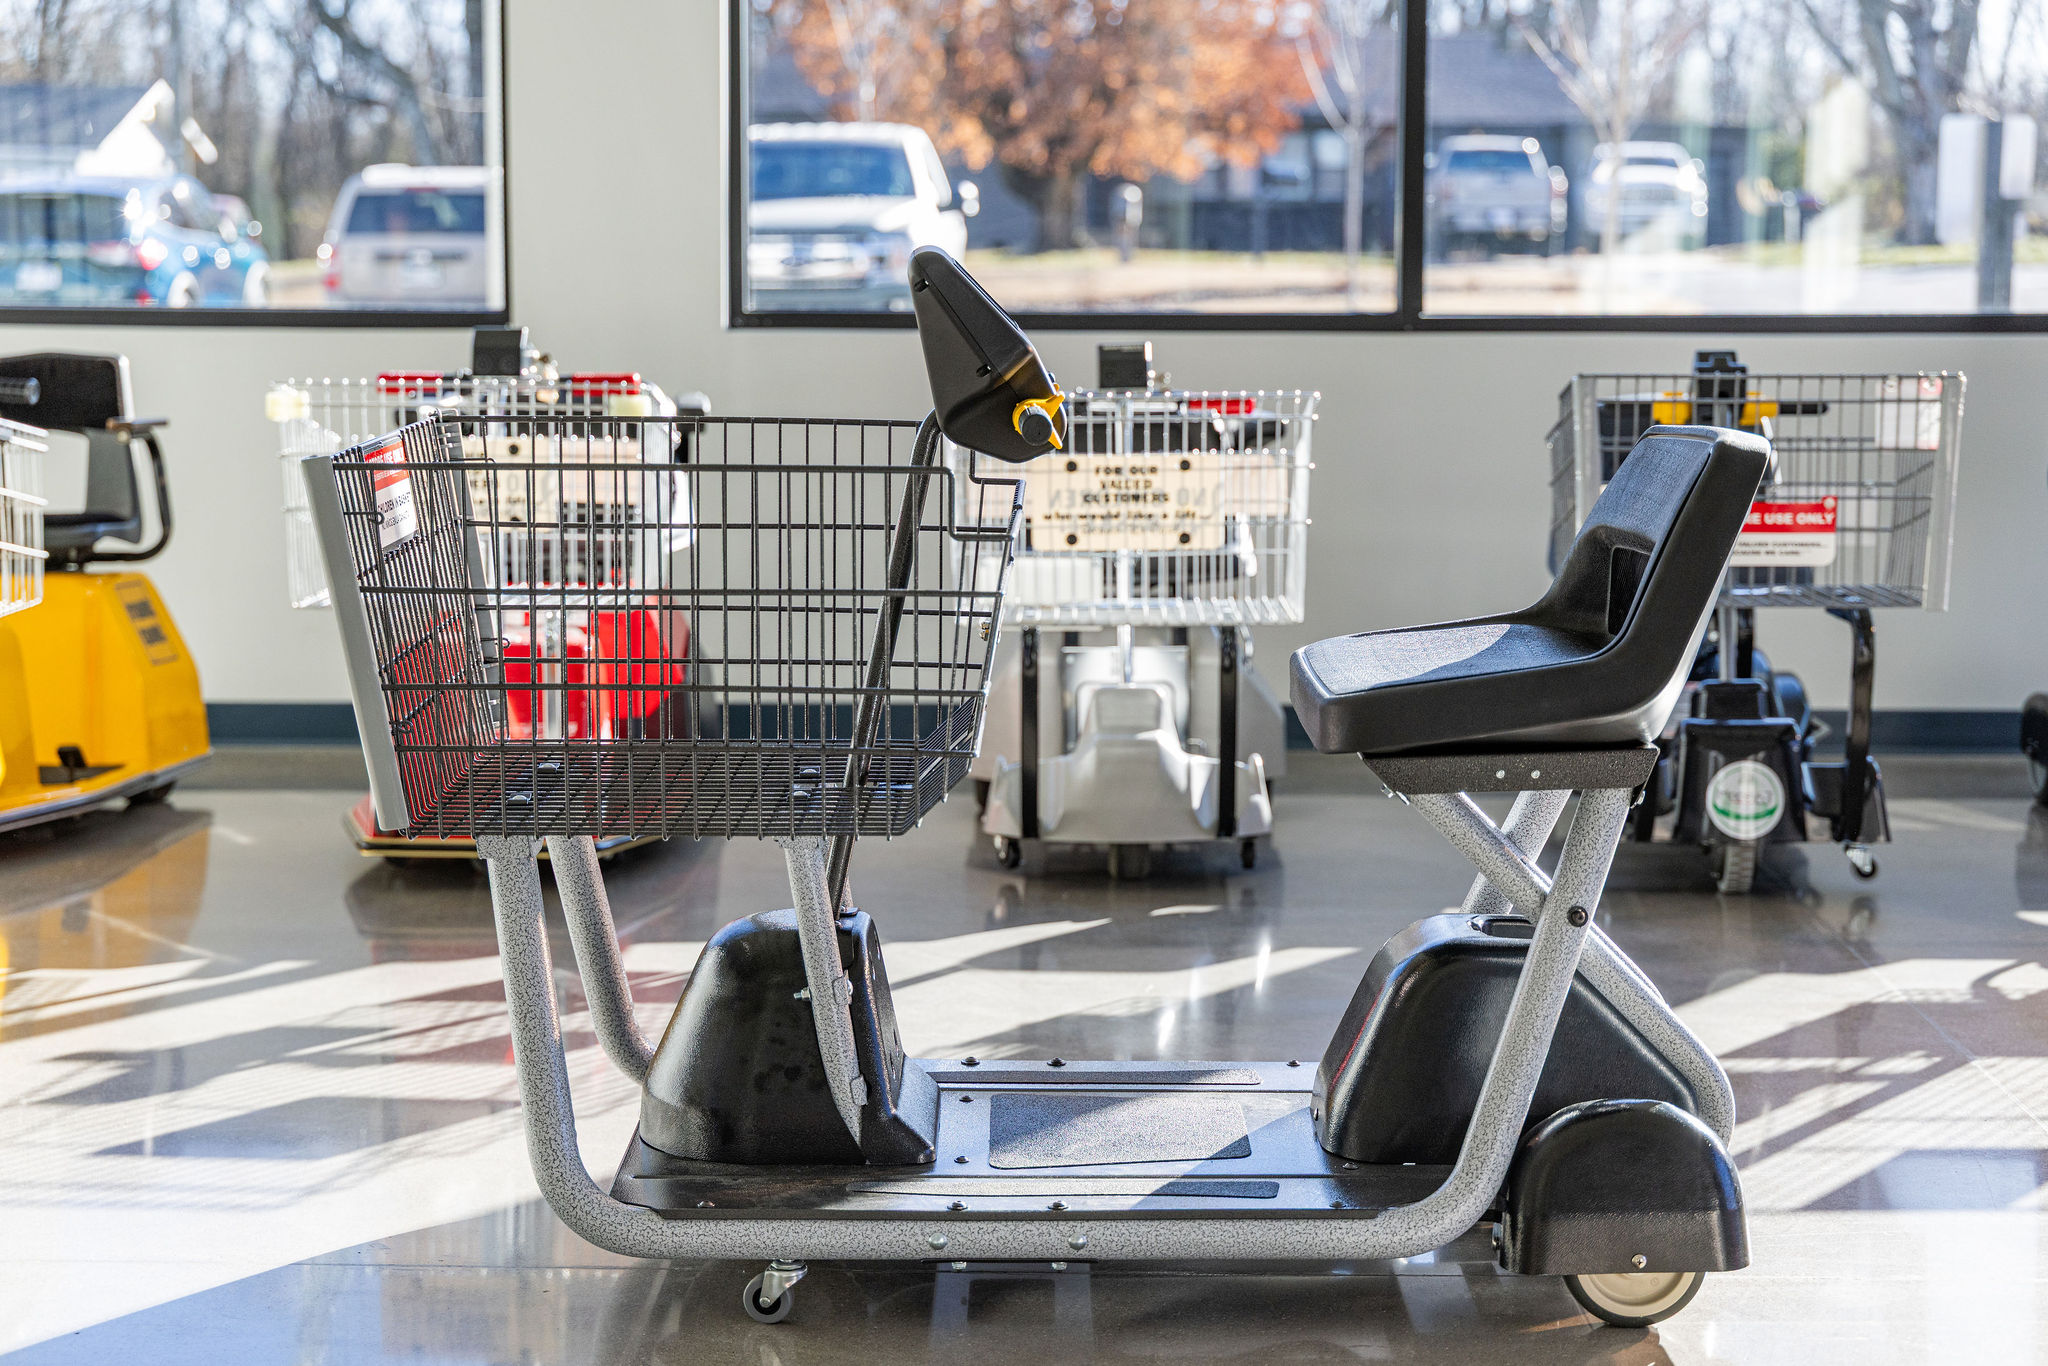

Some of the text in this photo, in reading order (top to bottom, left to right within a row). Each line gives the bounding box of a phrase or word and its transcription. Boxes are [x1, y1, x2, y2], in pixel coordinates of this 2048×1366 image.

[1095, 465, 1158, 475] FOR OUR
[1083, 493, 1169, 503] CUSTOMERS
[1764, 512, 1794, 525] USE
[1796, 512, 1835, 525] ONLY
